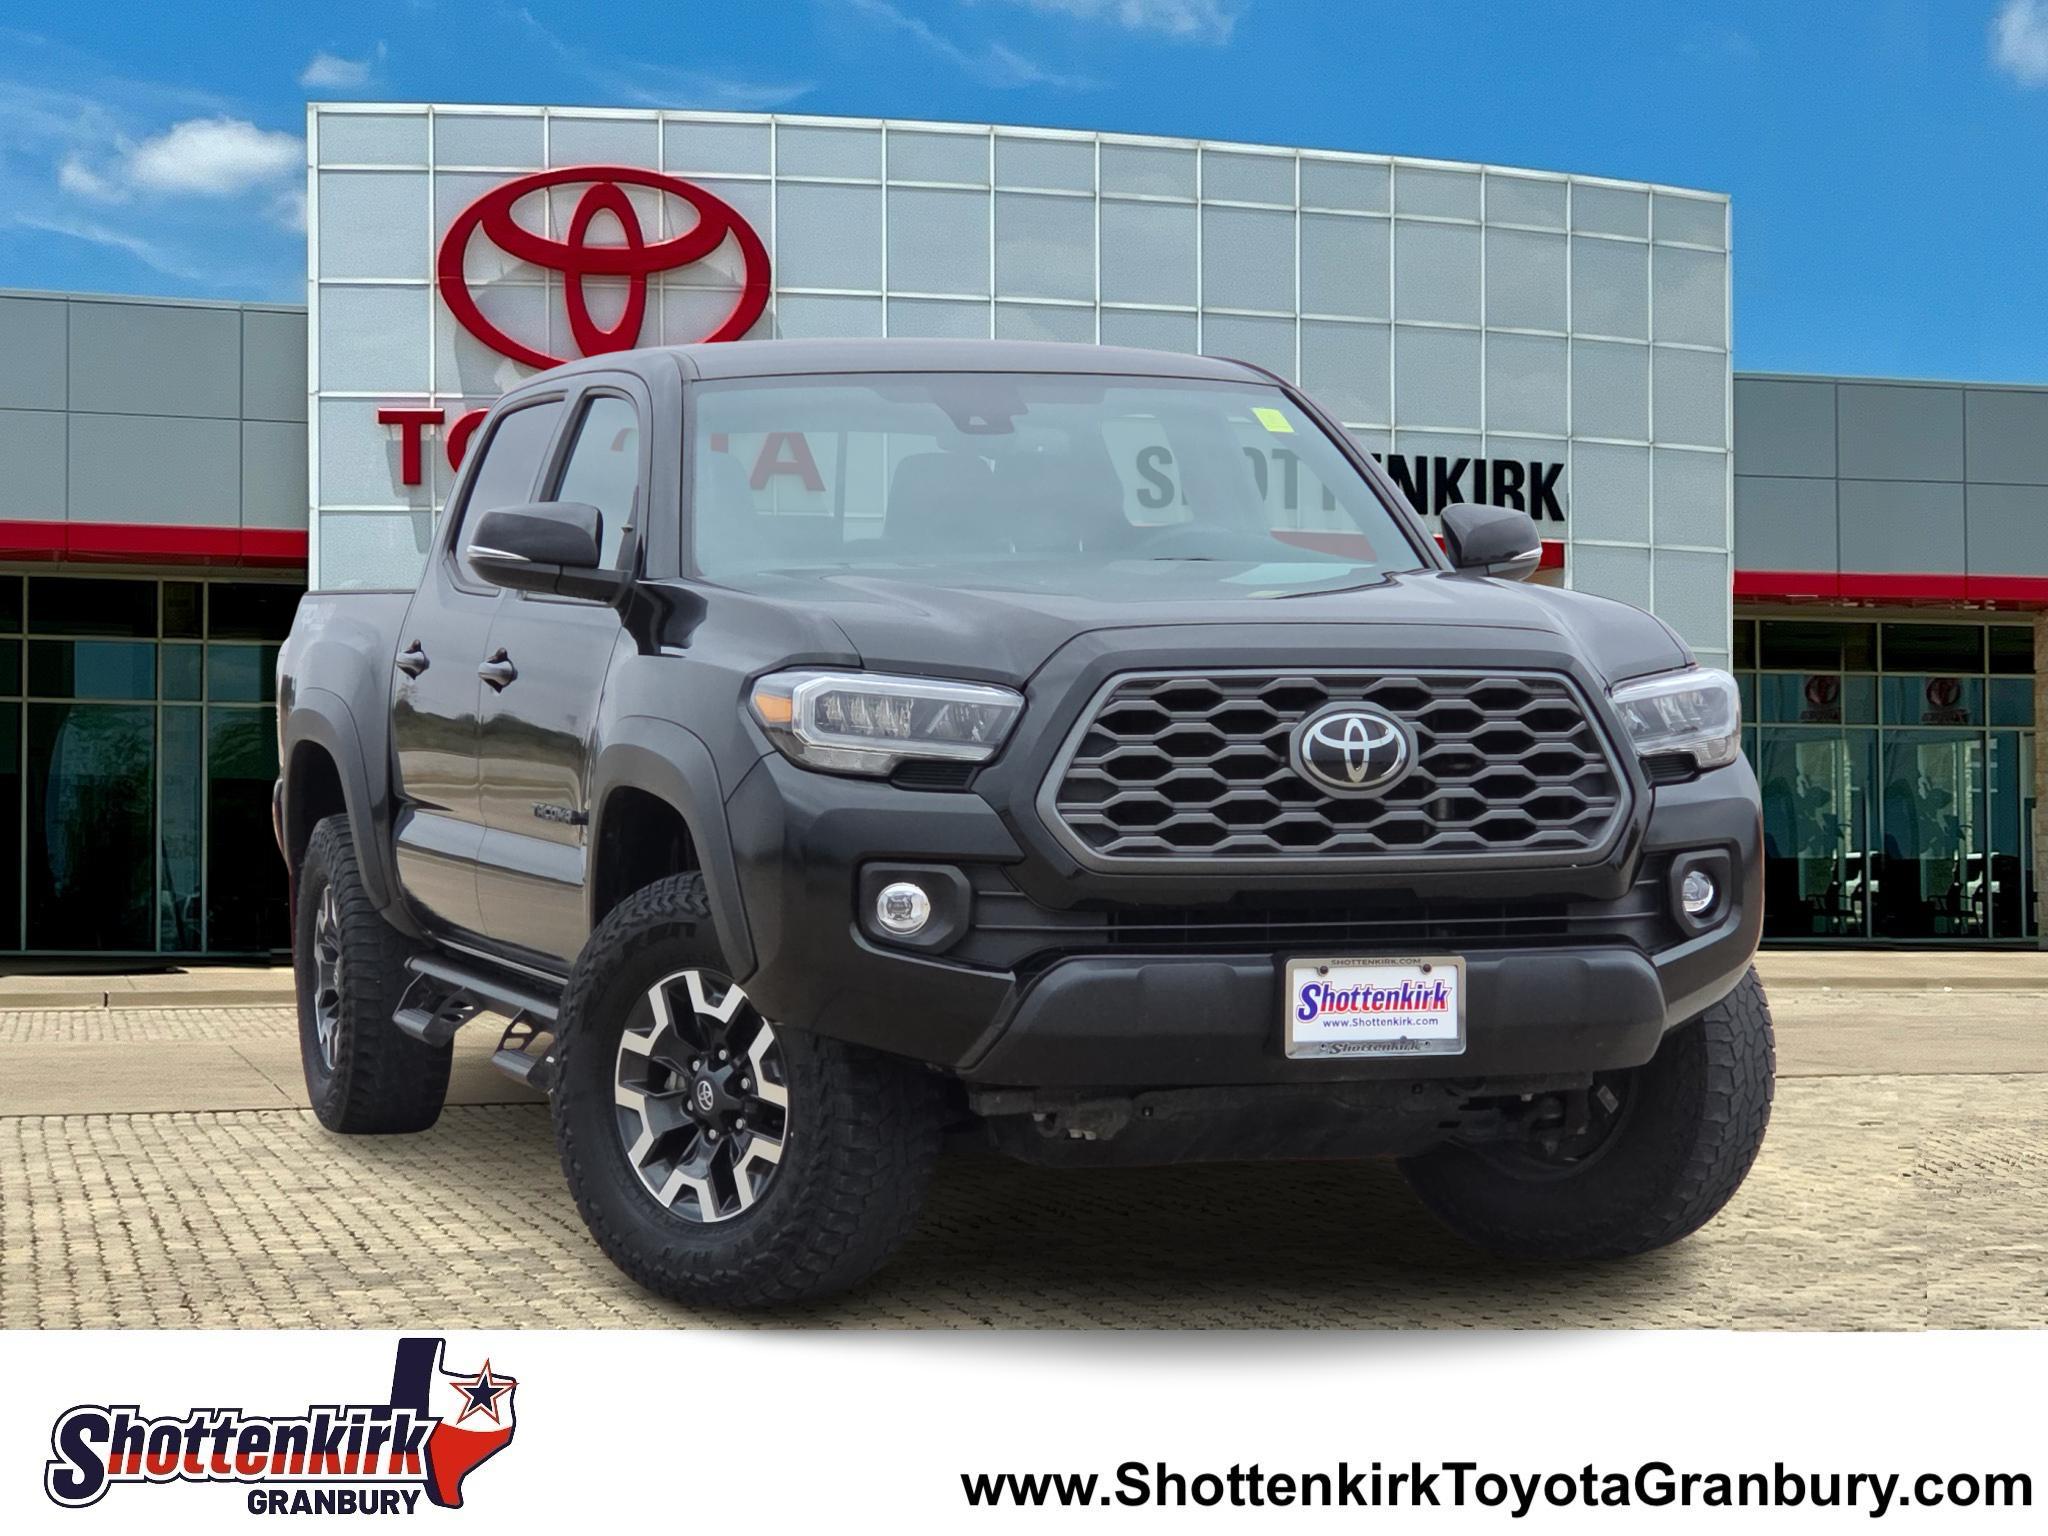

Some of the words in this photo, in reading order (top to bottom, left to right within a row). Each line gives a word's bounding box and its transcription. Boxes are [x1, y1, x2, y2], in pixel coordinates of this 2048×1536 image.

[1331, 958, 1421, 966] SHOTTENKIRK.COM
[1297, 980, 1449, 1022] Shottenkirk
[1323, 1017, 1439, 1027] www.Shottenkirk.com
